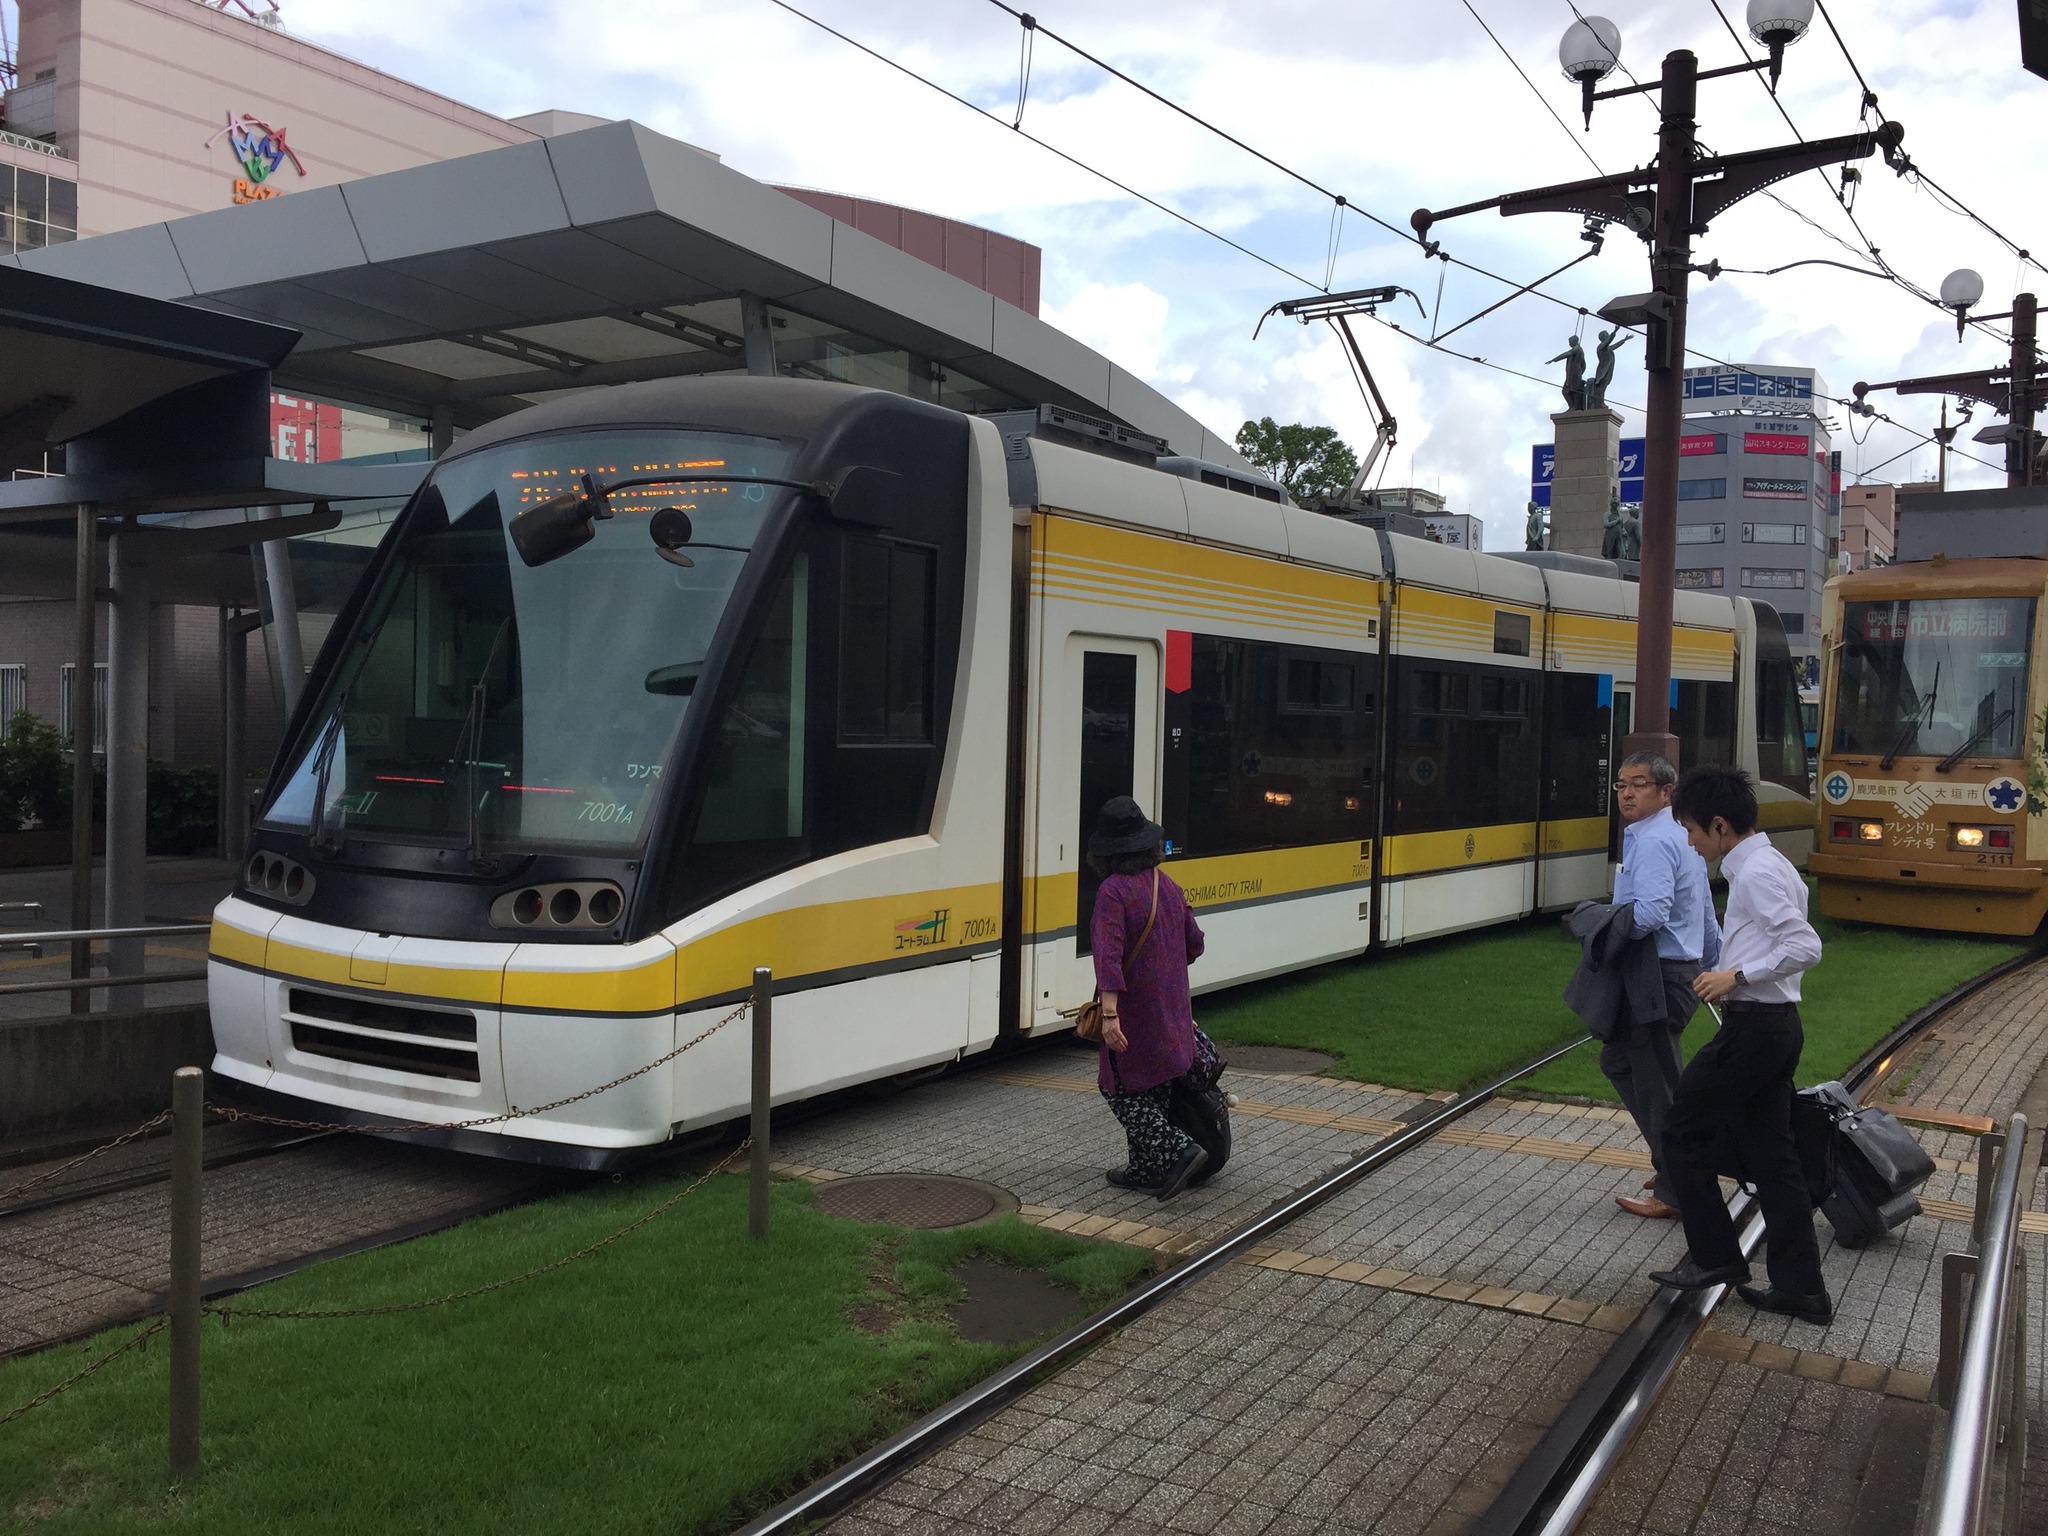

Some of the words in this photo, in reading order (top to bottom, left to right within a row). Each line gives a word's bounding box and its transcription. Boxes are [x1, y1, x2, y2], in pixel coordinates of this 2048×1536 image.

[234, 179, 284, 200] PLAZ
[1755, 400, 1812, 411] ユーミーマンション
[1910, 607, 2009, 638] 市立病院前
[1979, 654, 2027, 666] ワンマン
[1856, 784, 1899, 797] 鹿児島市
[1934, 788, 1979, 800] 大垣市
[1885, 821, 1946, 836] フレンドリー
[1891, 836, 1937, 850] シティ号
[1976, 853, 2014, 865] 2111
[1218, 881, 1239, 899] CITY
[1240, 878, 1263, 896] TRAM
